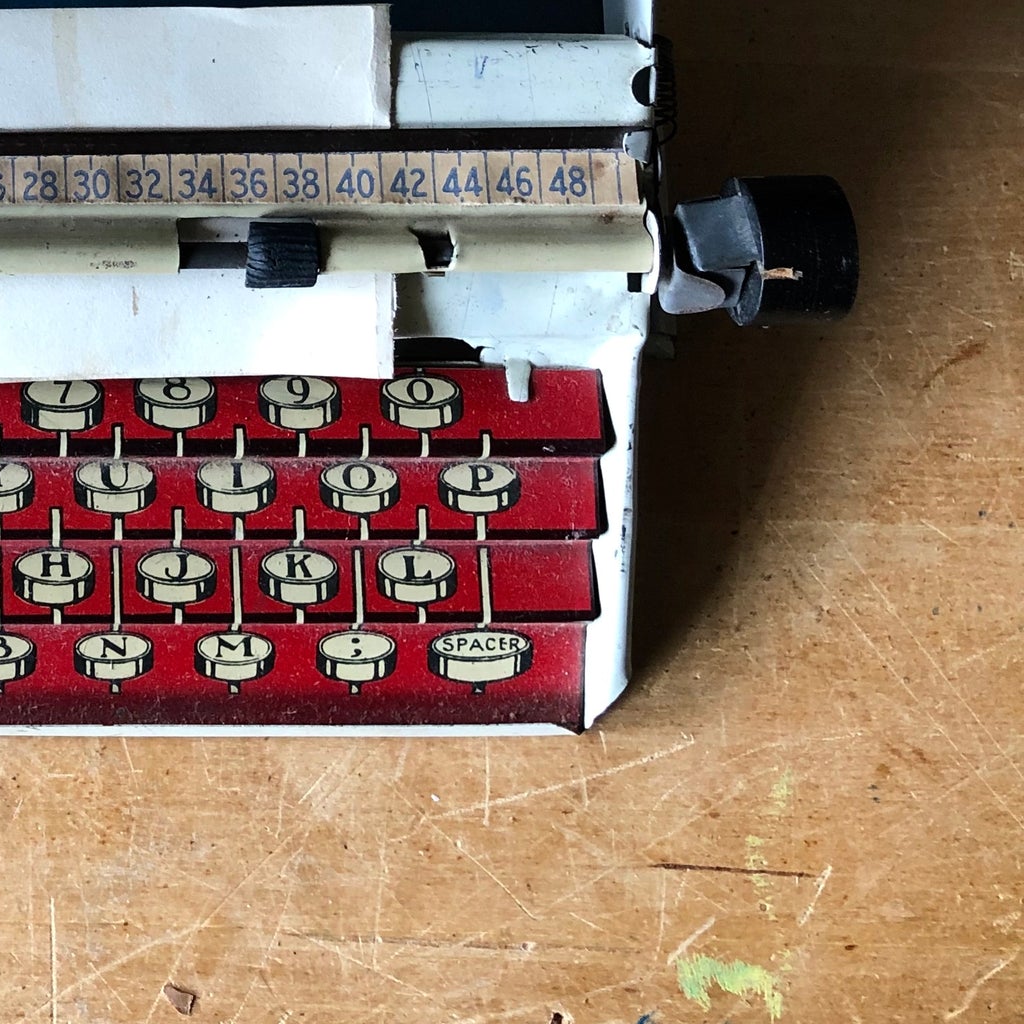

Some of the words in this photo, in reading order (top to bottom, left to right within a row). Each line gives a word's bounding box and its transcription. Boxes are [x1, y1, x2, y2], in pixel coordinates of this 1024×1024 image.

[22, 170, 59, 201] 28
[73, 168, 111, 200] 30
[126, 168, 163, 200] 32
[178, 168, 218, 199] 34
[230, 168, 268, 199] 36
[282, 167, 321, 199] 38
[335, 168, 375, 199] 40
[389, 167, 427, 198] 42
[442, 166, 483, 198] 44
[496, 166, 533, 198] 46
[549, 165, 588, 197] 48
[52, 380, 73, 404] 7
[166, 377, 192, 402] 8
[286, 377, 310, 404] 9
[99, 463, 131, 490] U
[469, 463, 494, 491] P
[40, 553, 73, 578] H
[164, 552, 188, 581] J
[284, 553, 312, 578] K
[403, 555, 432, 582] L
[99, 637, 129, 658] N
[215, 636, 254, 658] M
[441, 636, 520, 652] SPACER
